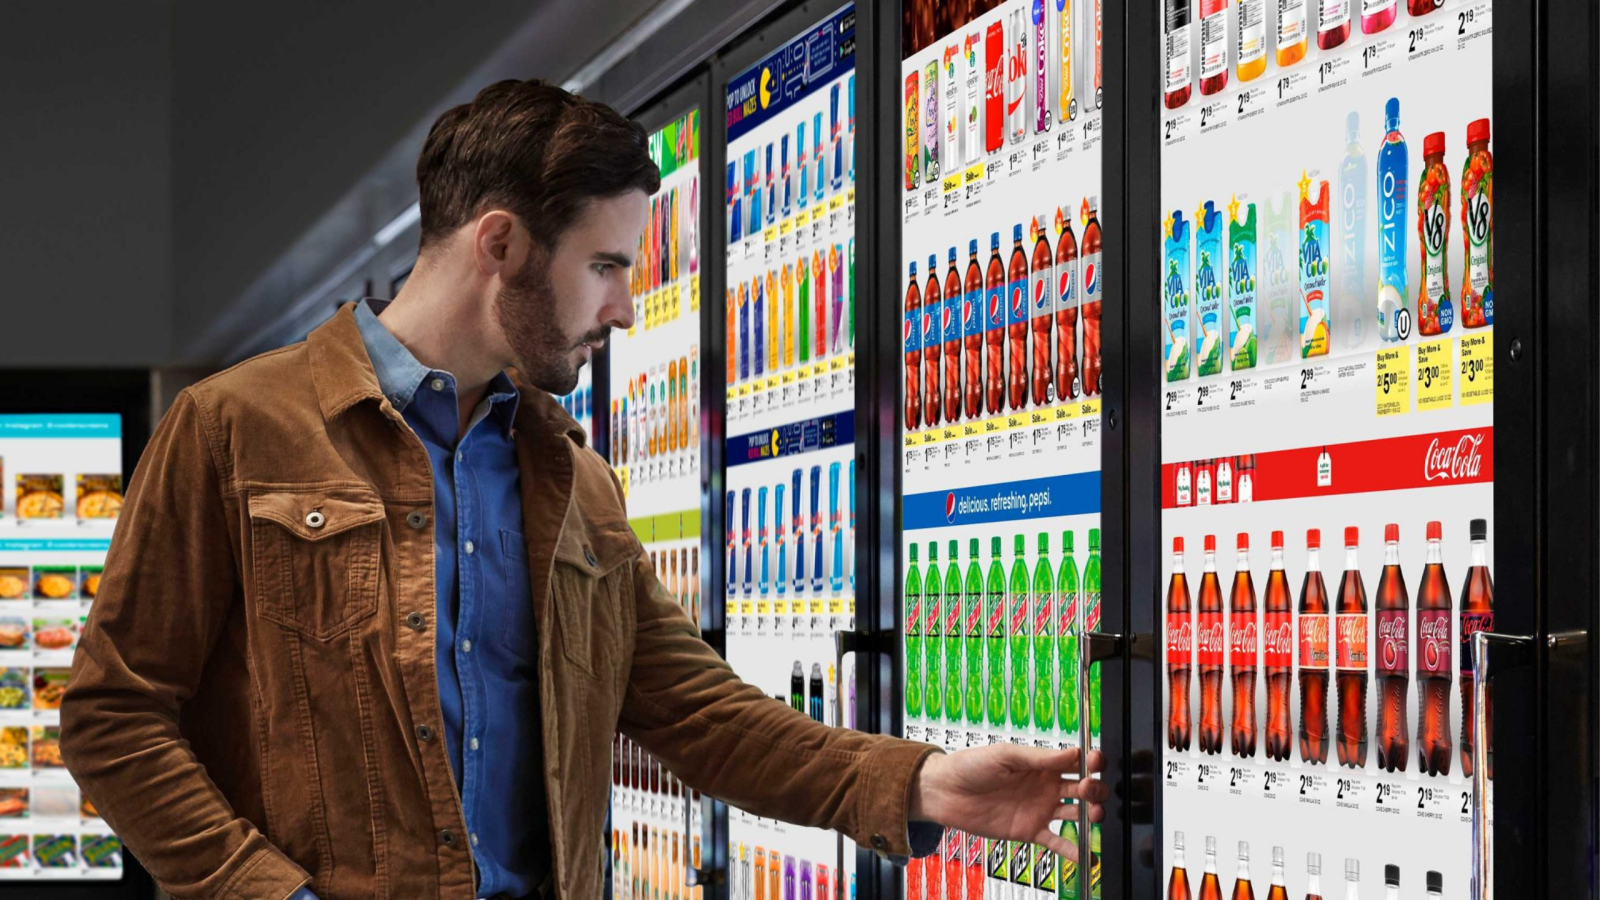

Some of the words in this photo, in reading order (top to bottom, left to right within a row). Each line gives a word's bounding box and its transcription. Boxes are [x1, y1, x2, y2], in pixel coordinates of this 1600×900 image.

[1062, 9, 1070, 63] Coke
[1383, 171, 1396, 255] ZICO
[1424, 199, 1444, 250] V8
[1468, 187, 1489, 240] V8
[1302, 239, 1322, 264] VITA
[1198, 266, 1216, 289] VITA
[1231, 259, 1249, 281] VITA
[1306, 257, 1328, 278] COCO
[1167, 274, 1184, 295] VITA
[1235, 275, 1255, 295] COCO
[1440, 308, 1452, 317] NON
[1440, 317, 1452, 326] GMO
[1418, 347, 1427, 355] Buy
[1427, 345, 1437, 354] More
[1461, 339, 1471, 348] Buy
[1471, 337, 1481, 346] More
[1462, 349, 1471, 357] Save
[1056, 409, 1066, 419] Sale
[1082, 404, 1091, 414] Sale
[1424, 433, 1485, 481] Coca-Cola
[959, 495, 989, 515] delicious.
[991, 491, 1028, 514] refreshing.
[1028, 487, 1052, 512] pepsi.
[1167, 622, 1191, 652] Coca-Cola
[1197, 622, 1223, 652] Coca-Cola
[1230, 622, 1257, 653] Coca-Cola
[1264, 622, 1292, 653] Coca-Cola
[1378, 616, 1405, 639] Coca-Cola
[1420, 616, 1448, 639] Coca-Cola
[1461, 791, 1472, 813] 21
[991, 840, 1005, 874] ICE
[1013, 842, 1027, 877] ICE
[1037, 849, 1051, 882] ICE
